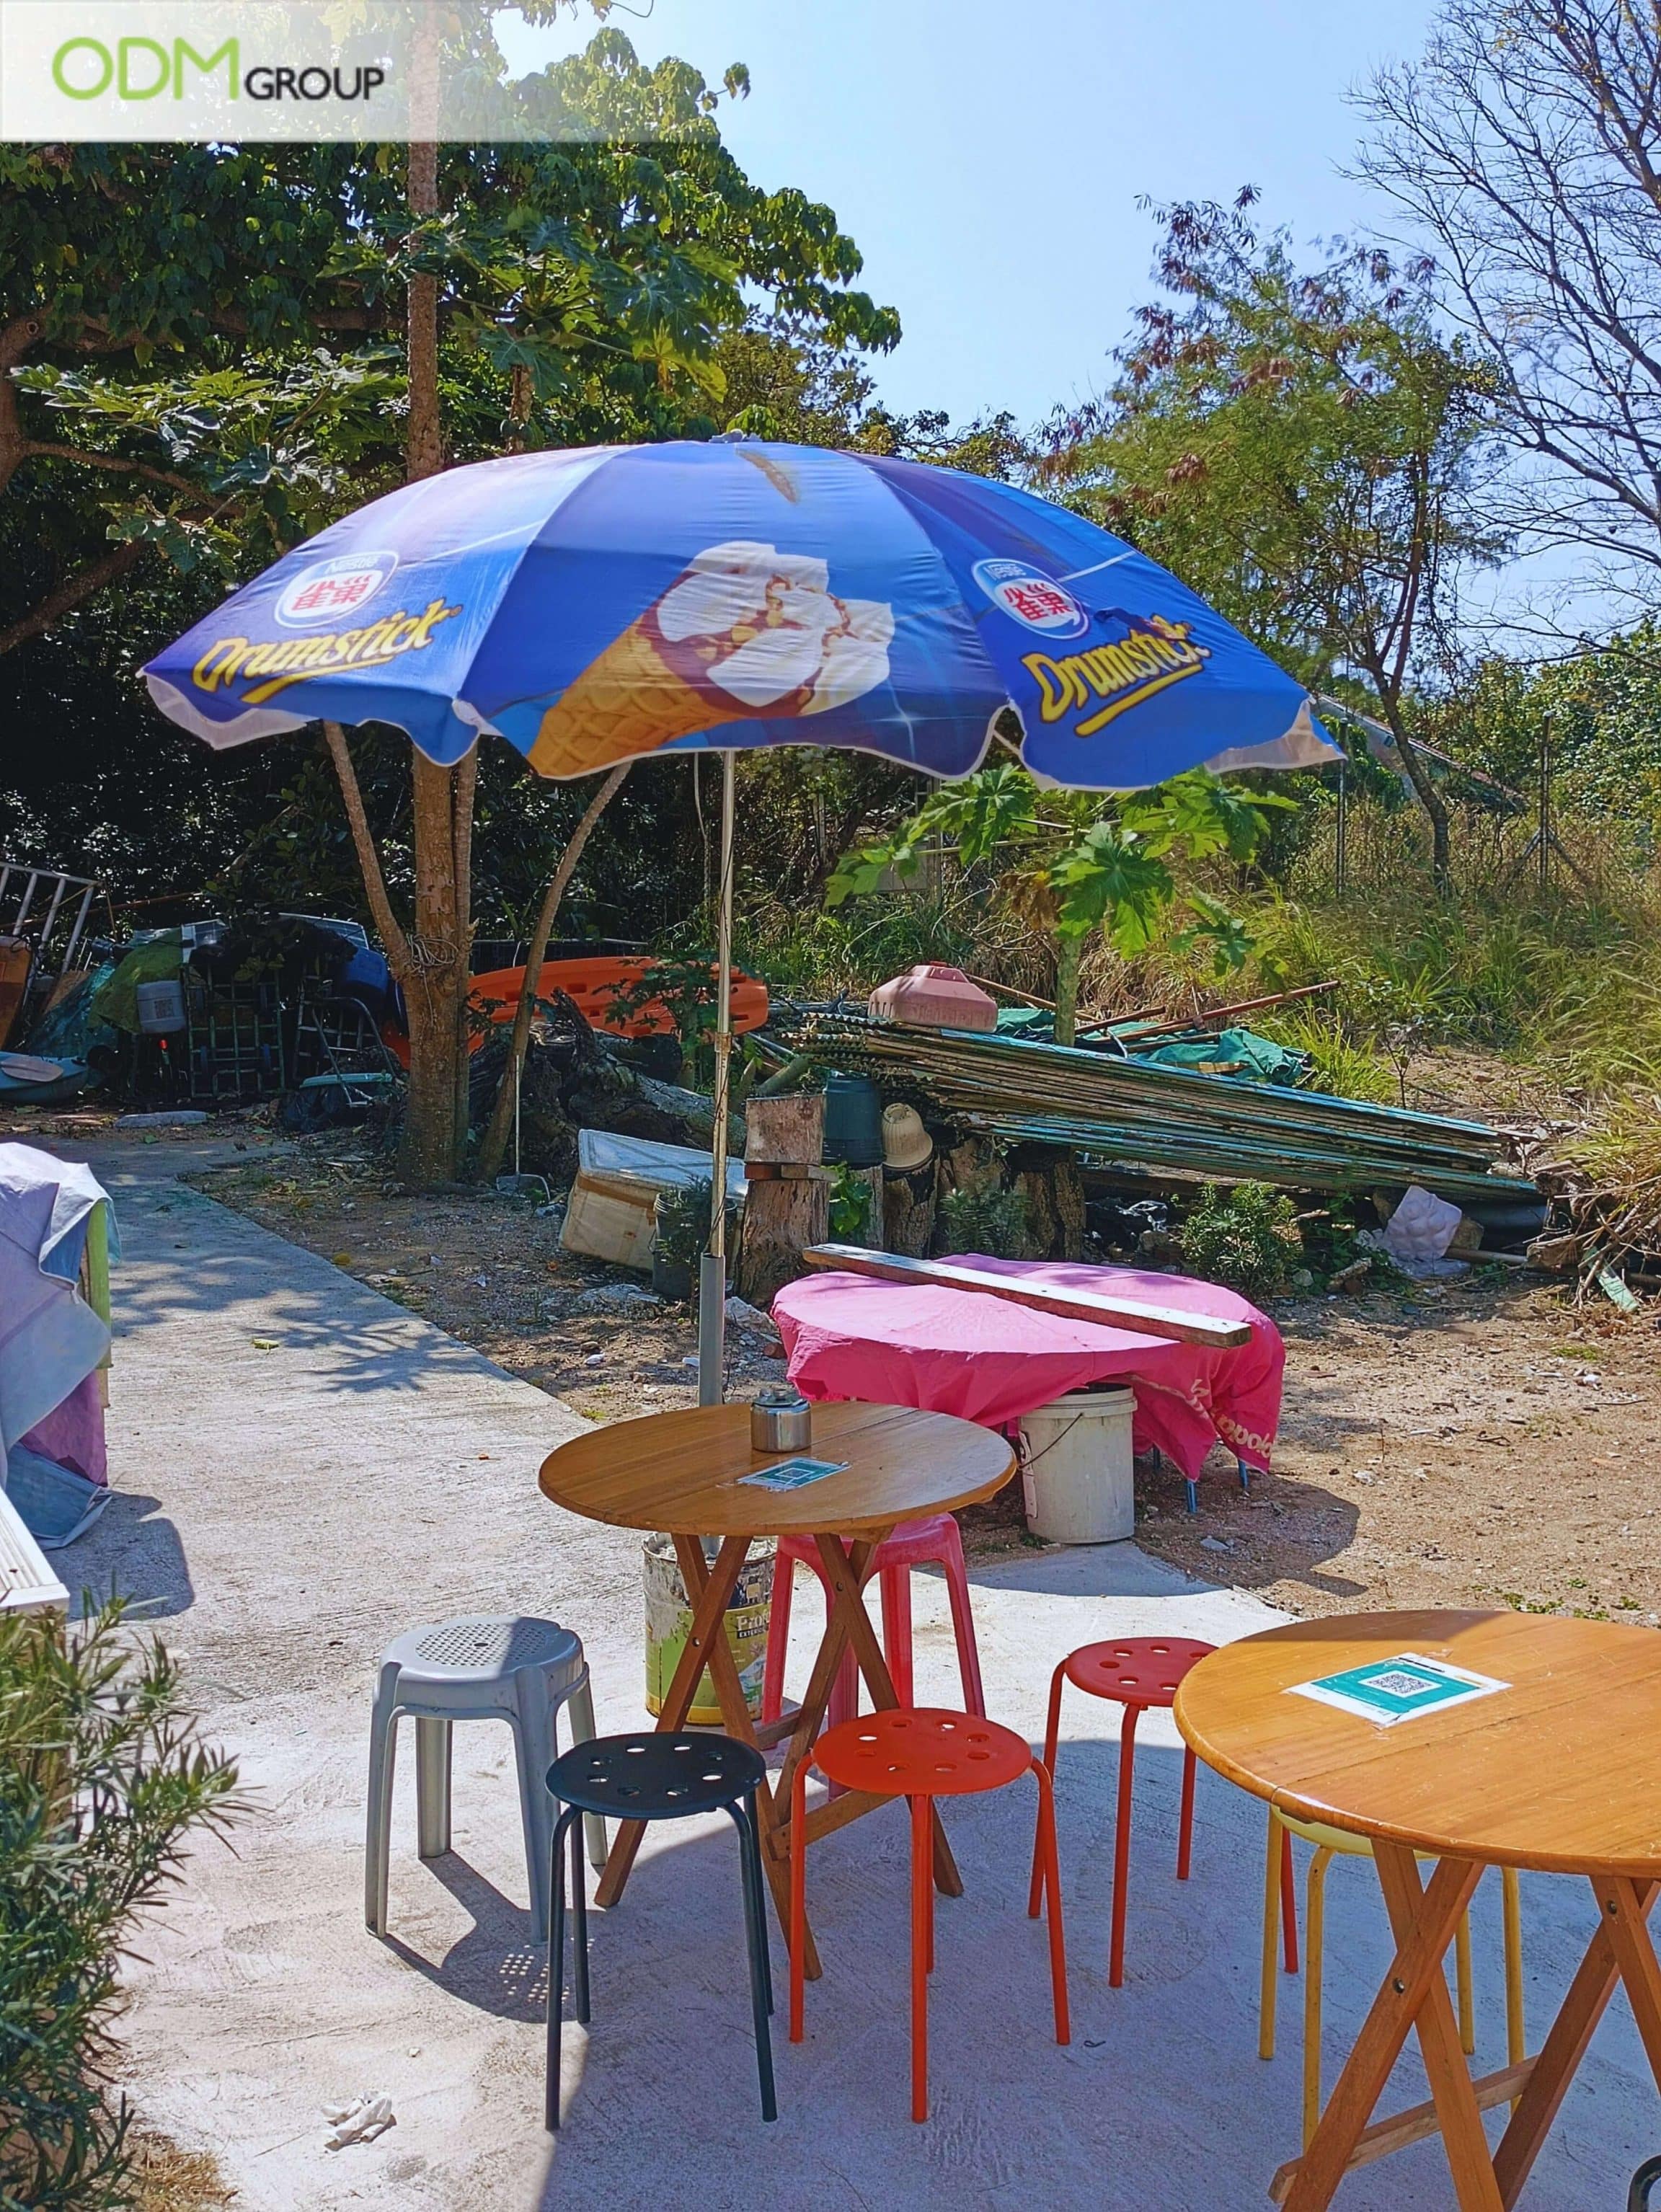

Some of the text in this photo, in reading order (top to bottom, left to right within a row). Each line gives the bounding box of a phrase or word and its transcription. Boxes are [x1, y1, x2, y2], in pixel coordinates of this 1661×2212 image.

[291, 574, 373, 611] 雀巢
[1004, 583, 1074, 621] 雀巢
[191, 598, 451, 694] Drumstick
